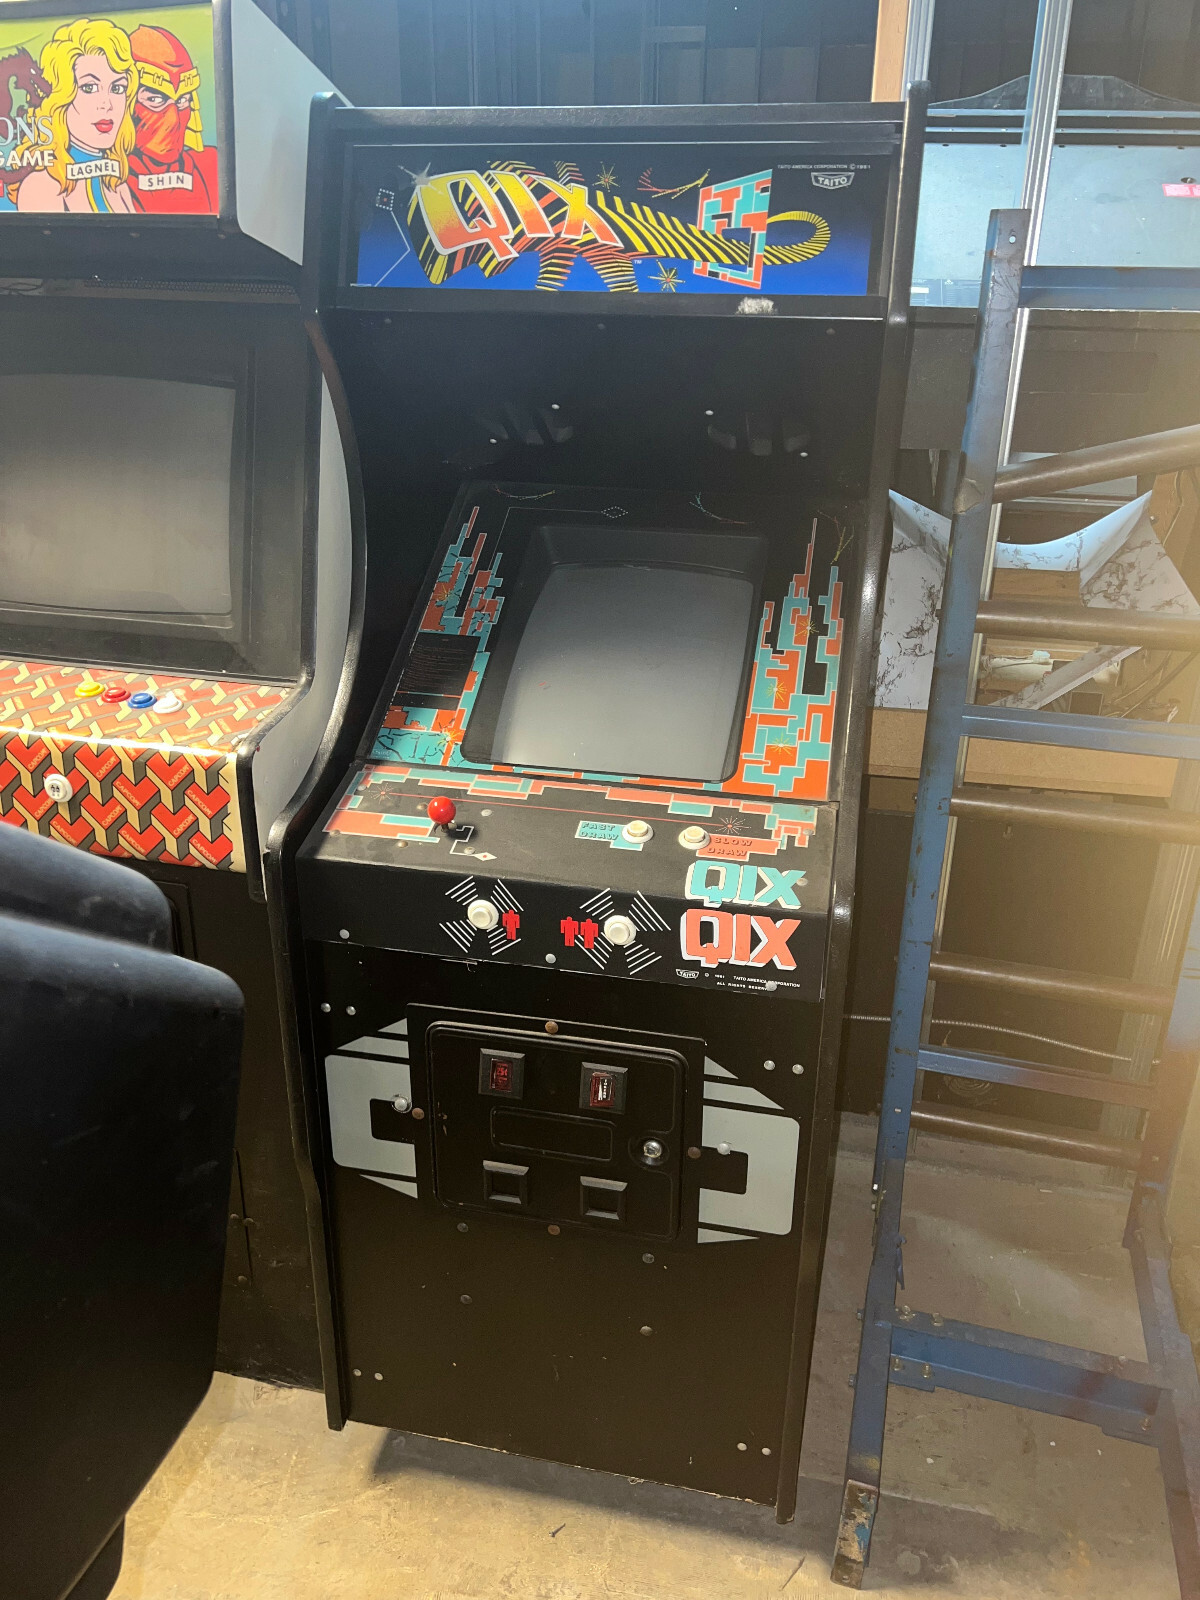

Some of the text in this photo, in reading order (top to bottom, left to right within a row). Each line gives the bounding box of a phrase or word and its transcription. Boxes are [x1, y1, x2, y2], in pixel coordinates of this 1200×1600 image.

[70, 161, 117, 177] LAGNEL
[147, 174, 185, 188] SHIN
[817, 176, 848, 187] TAITO
[411, 168, 625, 263] QIX
[26, 747, 48, 771] CAPCOM
[95, 756, 118, 779] CAPCOM
[167, 762, 191, 788] CAPCOM
[114, 780, 142, 808] CAPCOM
[186, 788, 214, 817] CAPCOM
[100, 803, 123, 827] CAPCOM
[172, 813, 196, 837] CAPCOM
[582, 822, 616, 832] FAST
[51, 819, 79, 846] CAPCOM
[120, 829, 147, 855] CAPCOM
[580, 831, 620, 840] DRAW
[714, 837, 753, 847] SLOW
[191, 838, 219, 864] CAPCOM
[708, 848, 748, 857] DRAW
[684, 860, 807, 909] QIX
[680, 908, 801, 971] QIX
